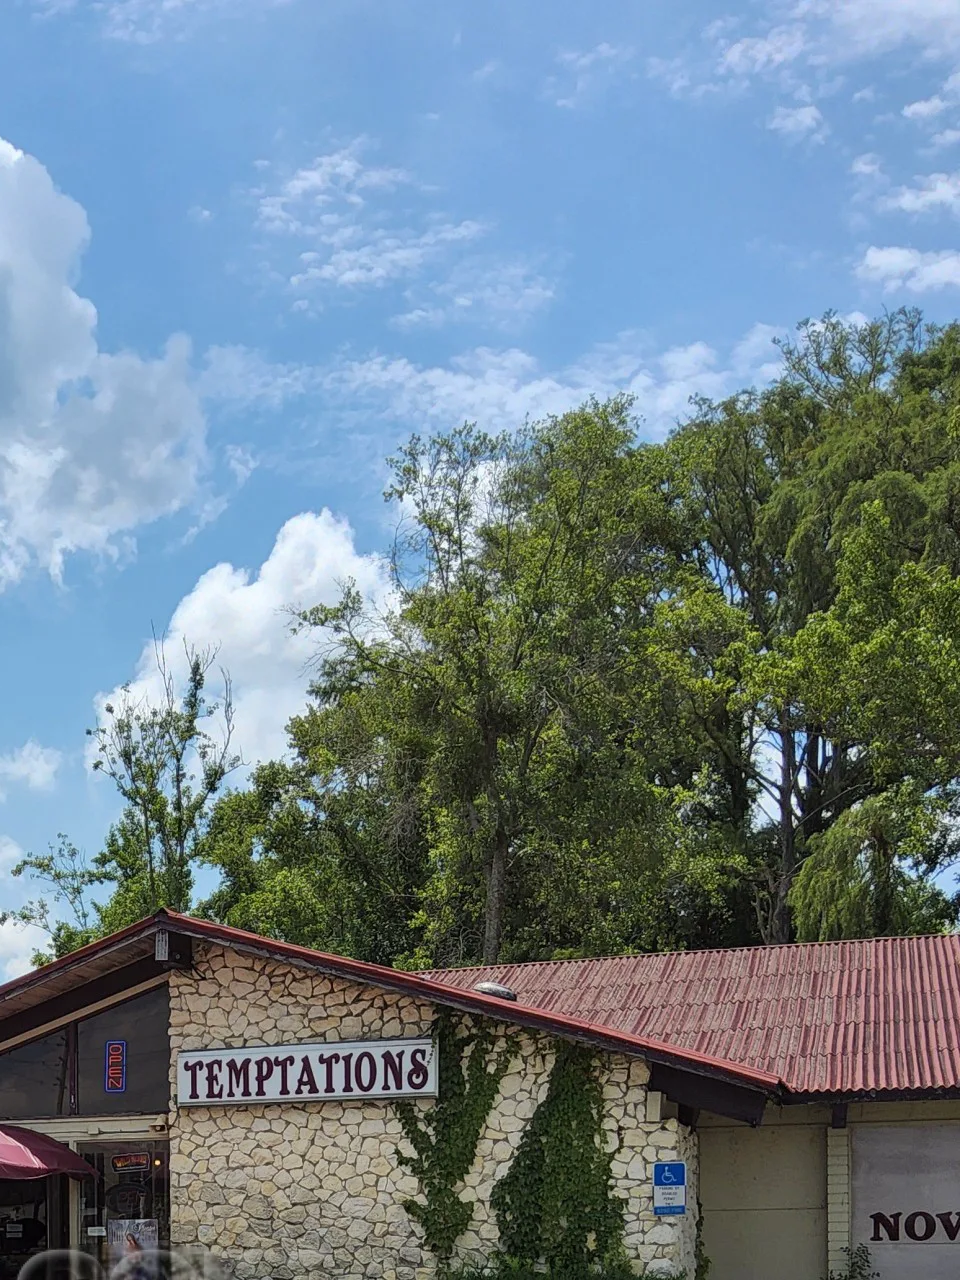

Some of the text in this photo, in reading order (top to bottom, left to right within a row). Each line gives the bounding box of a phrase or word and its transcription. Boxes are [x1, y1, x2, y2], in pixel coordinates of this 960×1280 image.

[109, 1044, 123, 1088] OPEN
[184, 1049, 429, 1099] TEMPTATIONS
[869, 1211, 960, 1241] NOV
